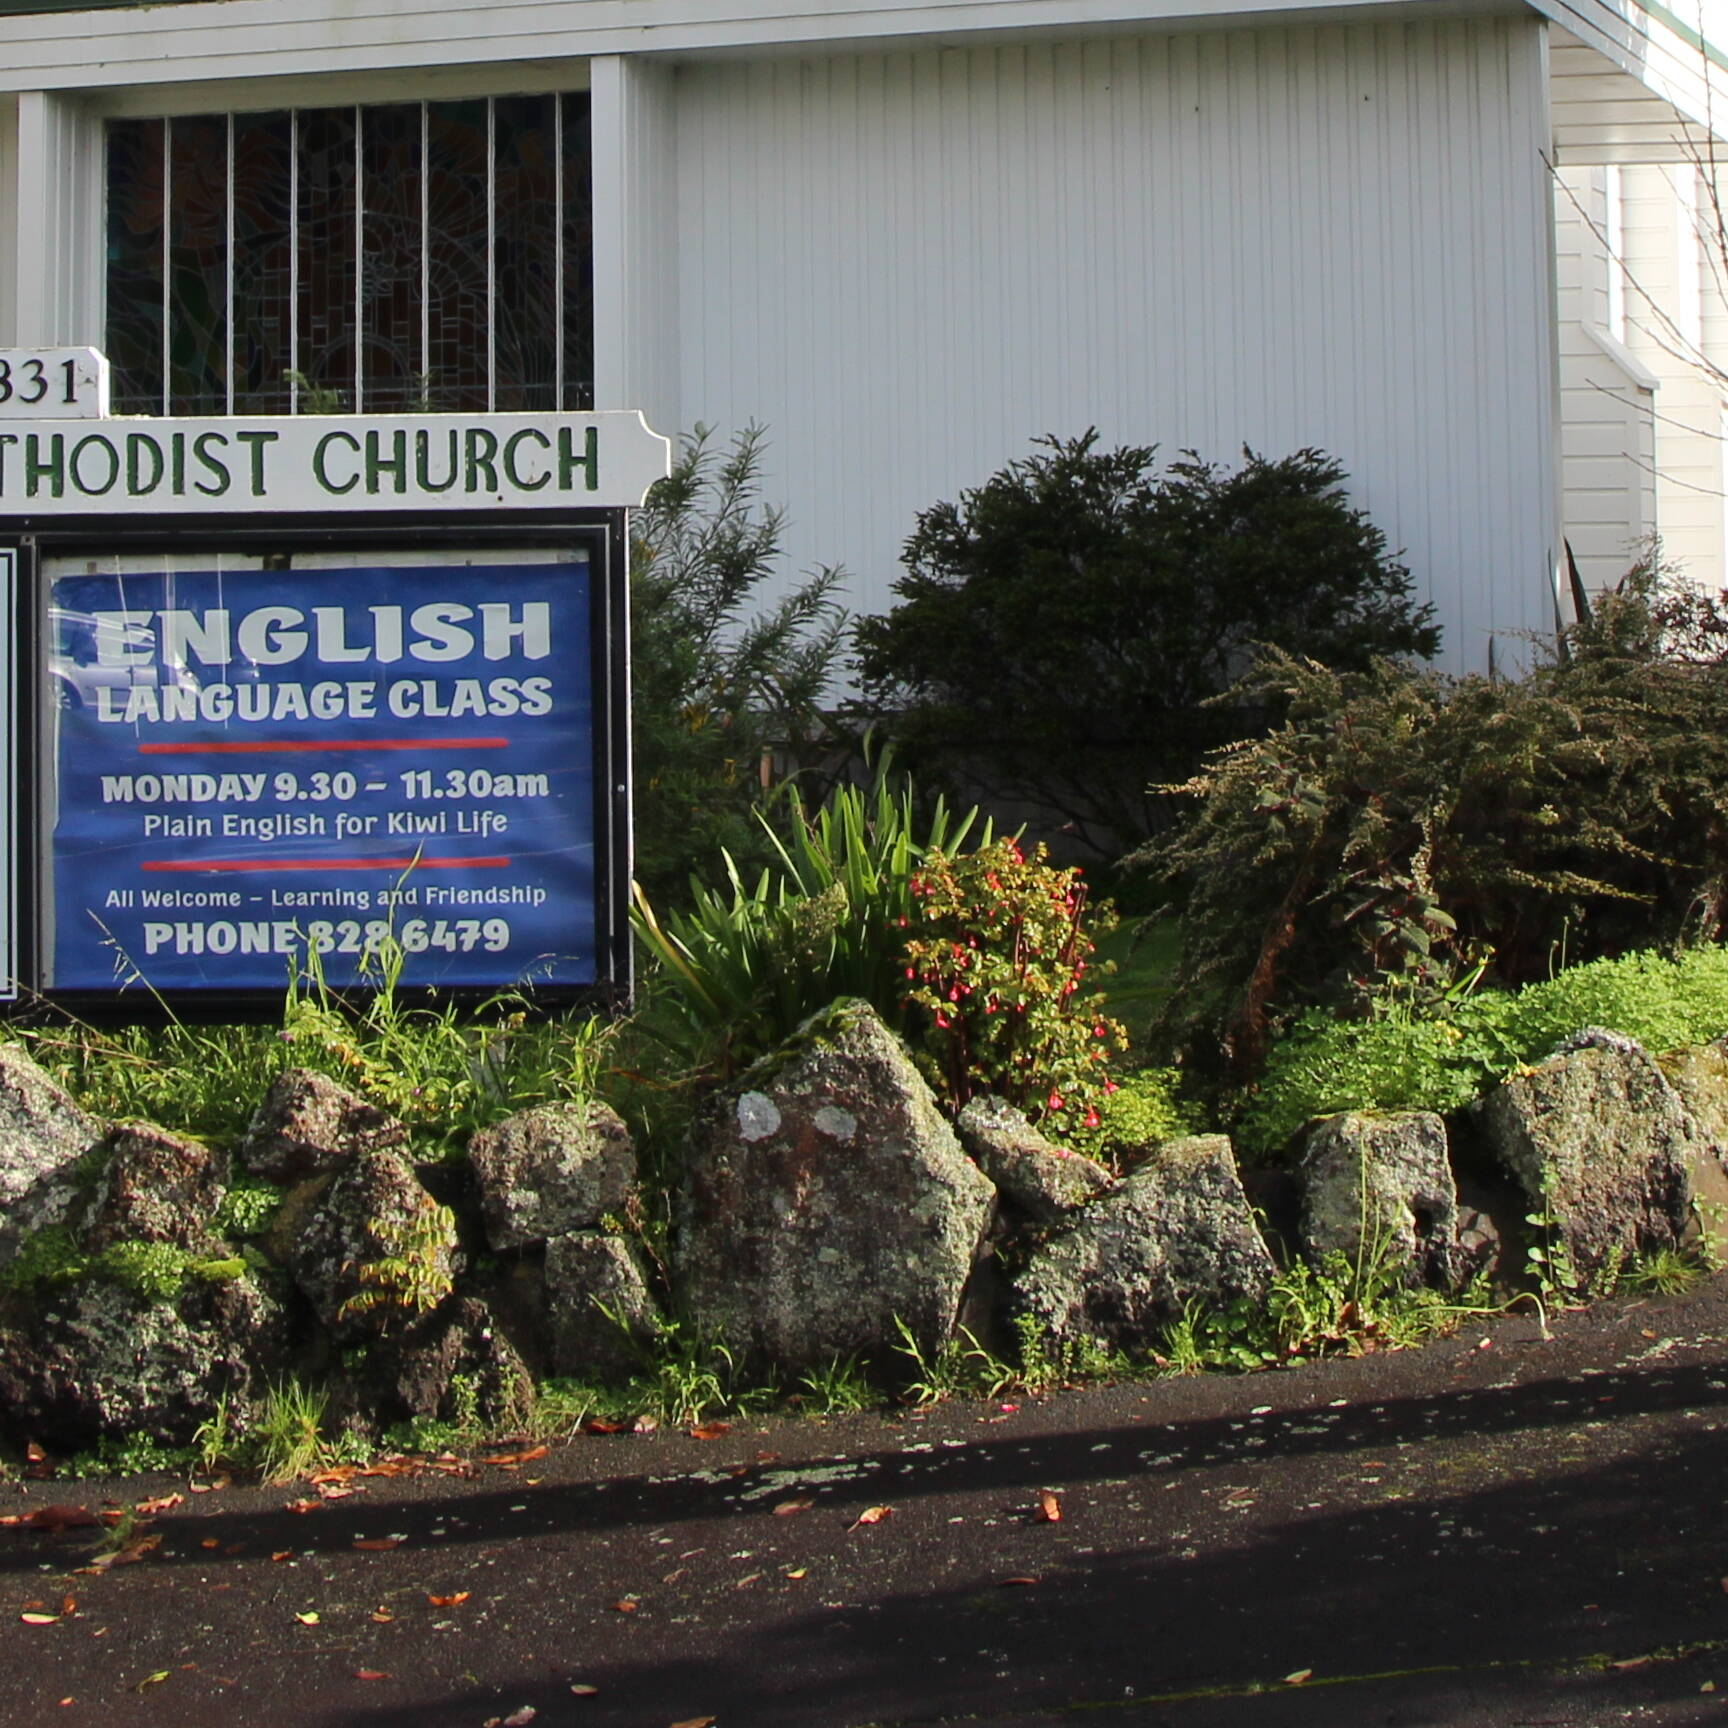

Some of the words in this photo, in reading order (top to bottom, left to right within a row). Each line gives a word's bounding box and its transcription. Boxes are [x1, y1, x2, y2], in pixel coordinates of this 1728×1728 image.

[312, 425, 599, 495] CHURCH
[92, 601, 552, 667] ENGLISH
[94, 680, 377, 724] LANGUAGE
[387, 676, 554, 720] CLASS
[101, 772, 268, 804] MONDAY
[273, 771, 358, 802] 9.30
[399, 768, 551, 800] 11.30am
[143, 813, 216, 838] Plain
[223, 813, 328, 842] English
[334, 811, 380, 840] for
[387, 810, 448, 836] Kiwi
[456, 810, 509, 838] Life
[104, 888, 135, 909] All
[140, 887, 243, 909] Welcome
[271, 886, 370, 911] Learning
[376, 886, 419, 906] and
[425, 884, 548, 908] Friendship
[143, 920, 299, 955] PHONE
[308, 919, 390, 954] 828
[400, 918, 512, 954] 6479
